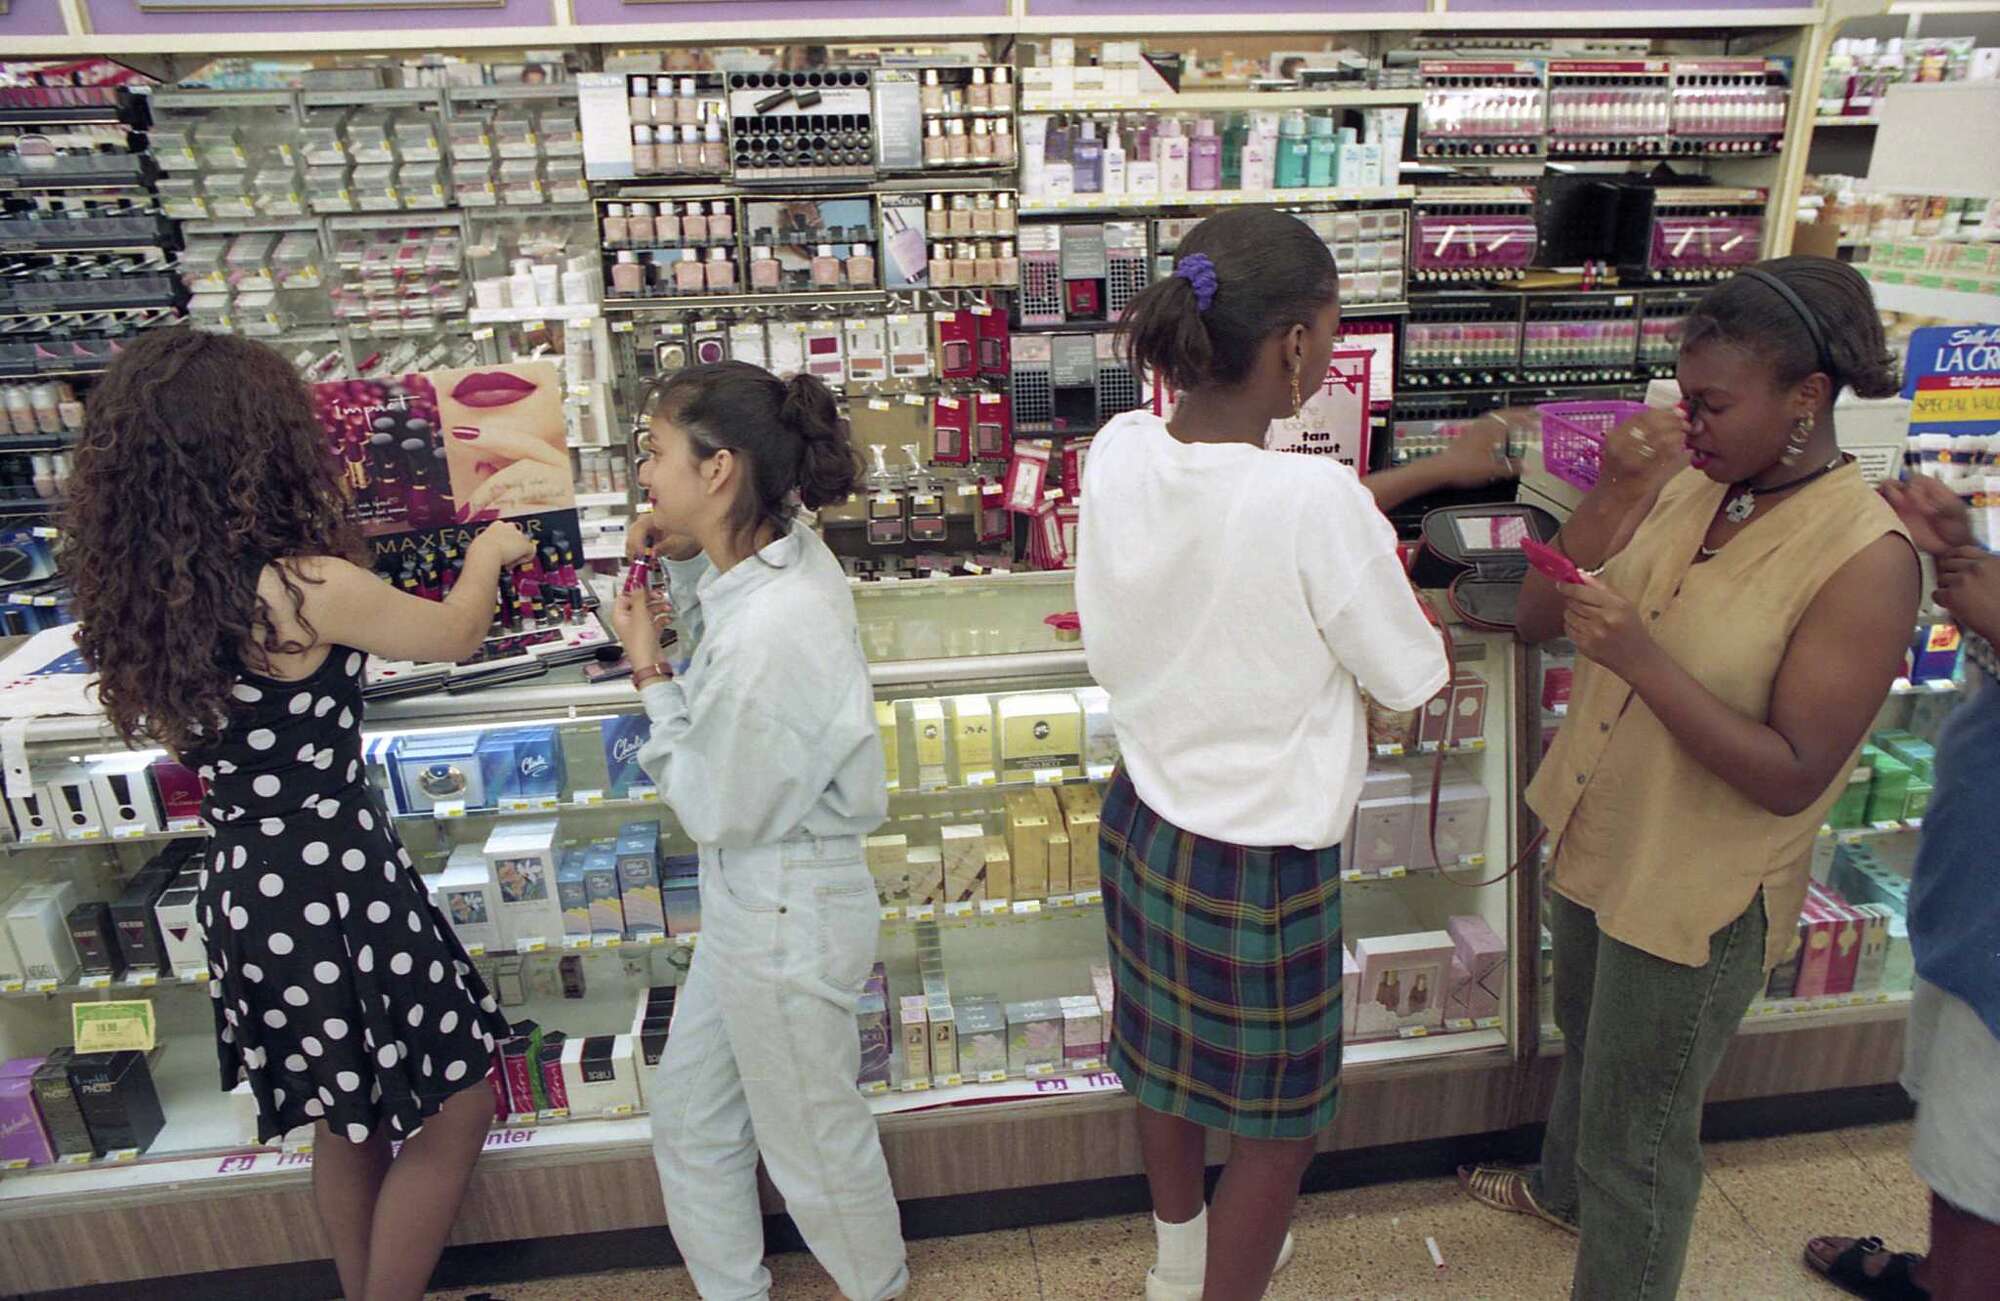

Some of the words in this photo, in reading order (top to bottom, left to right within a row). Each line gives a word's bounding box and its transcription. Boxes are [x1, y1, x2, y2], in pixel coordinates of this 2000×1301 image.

[332, 394, 421, 431] impact
[1302, 431, 1331, 442] tan
[487, 1129, 537, 1145] nter
